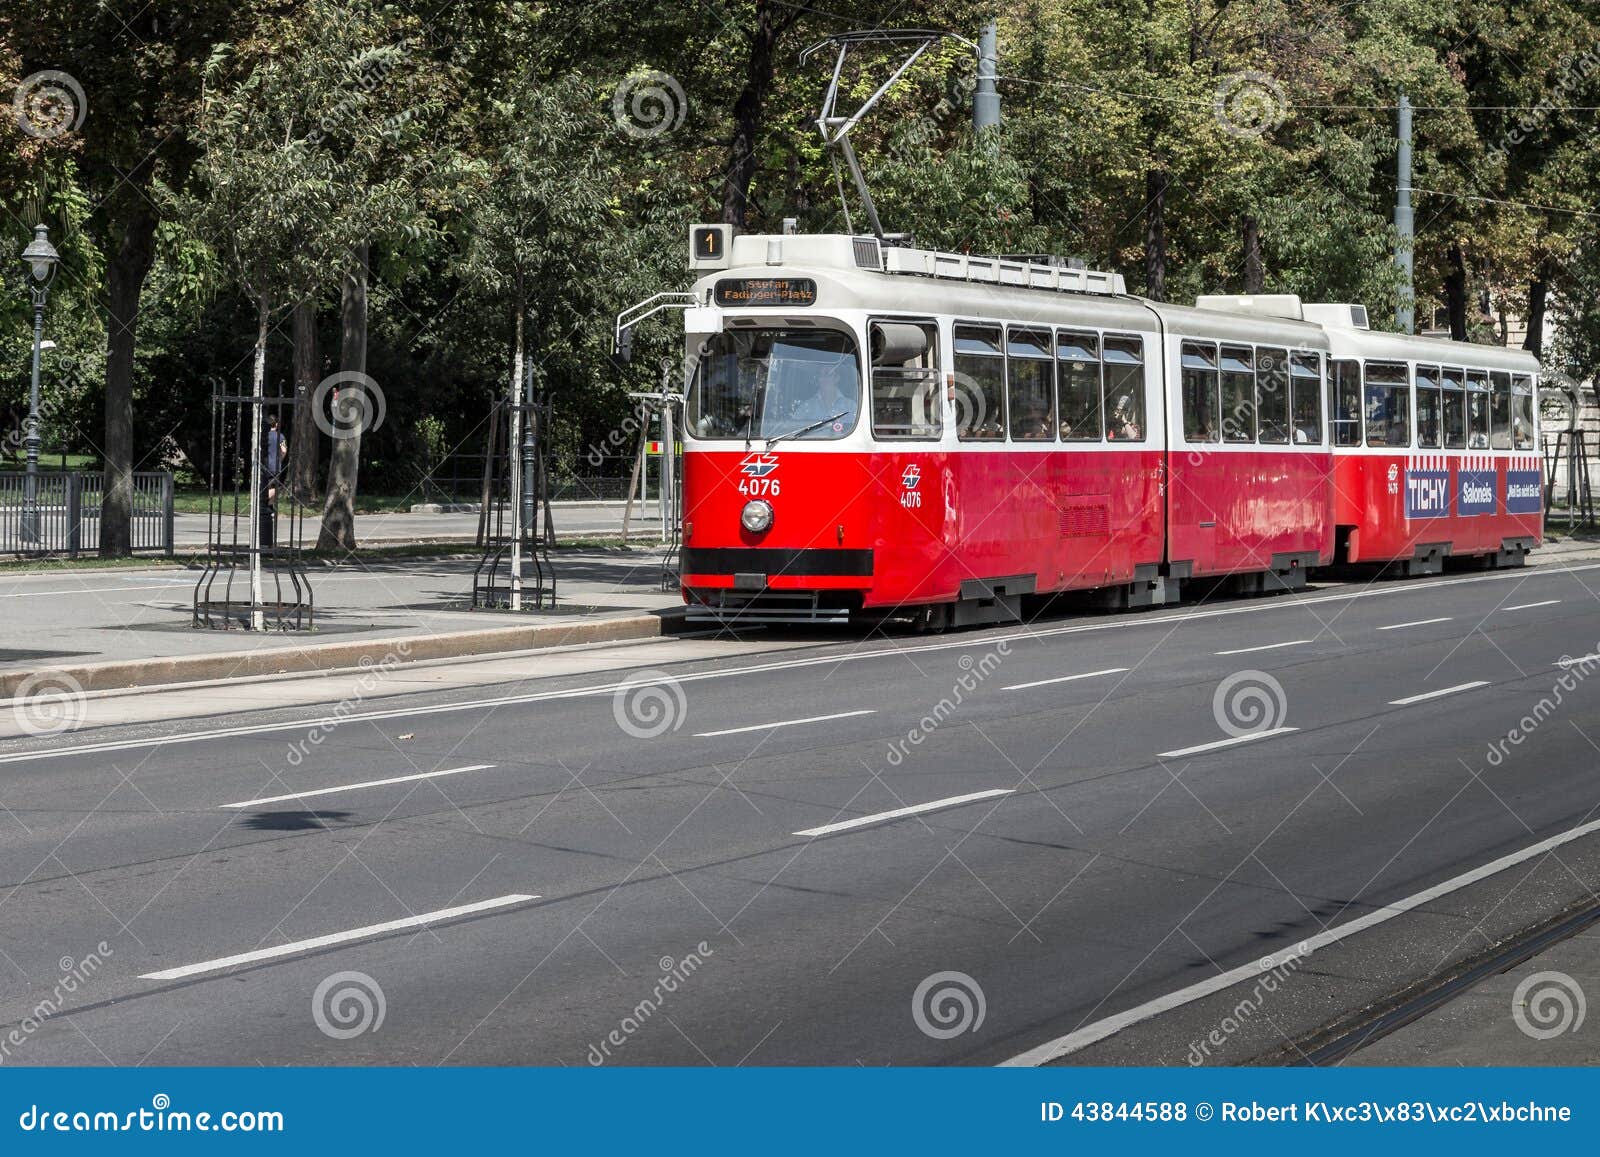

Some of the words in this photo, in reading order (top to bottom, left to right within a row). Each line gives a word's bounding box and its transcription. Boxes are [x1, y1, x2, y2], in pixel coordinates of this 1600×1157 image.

[705, 233, 714, 253] 1
[738, 479, 781, 496] 4076
[1408, 478, 1447, 511] TICHY
[901, 491, 921, 508] 4076
